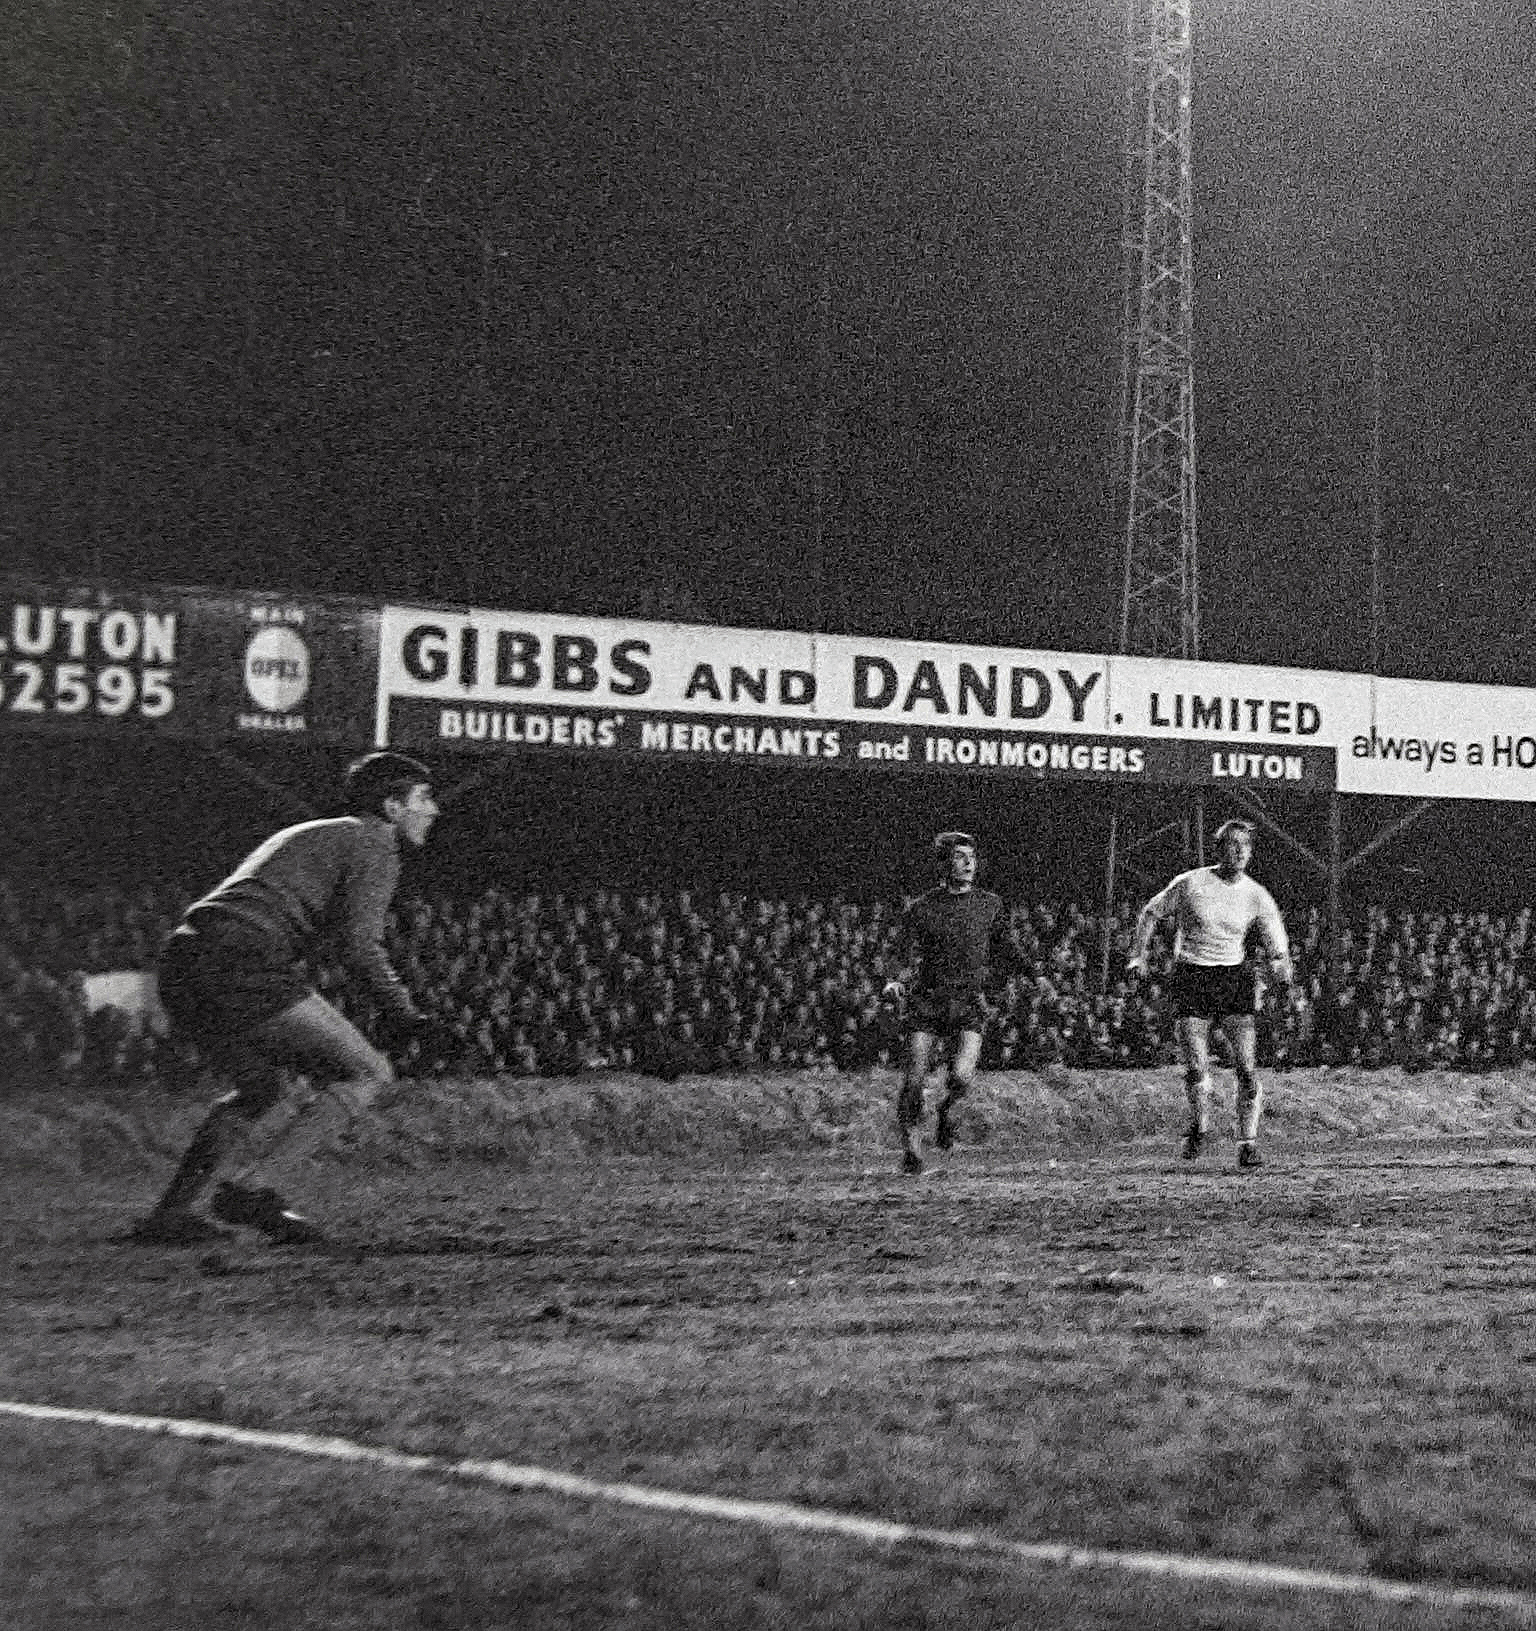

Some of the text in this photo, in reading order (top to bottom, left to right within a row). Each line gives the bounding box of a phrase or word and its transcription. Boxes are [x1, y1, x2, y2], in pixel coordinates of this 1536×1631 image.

[0, 604, 176, 663] UTON
[0, 661, 174, 717] 2595
[402, 624, 652, 695] GIBBS
[685, 661, 817, 706] AND
[1150, 692, 1321, 735] LIMITED
[640, 722, 841, 758] MERCHANTS
[858, 737, 909, 762] and
[925, 737, 1145, 773] IRONMONGERS
[1212, 752, 1302, 780] LUTON
[1352, 726, 1457, 773] always
[1466, 740, 1484, 766] a
